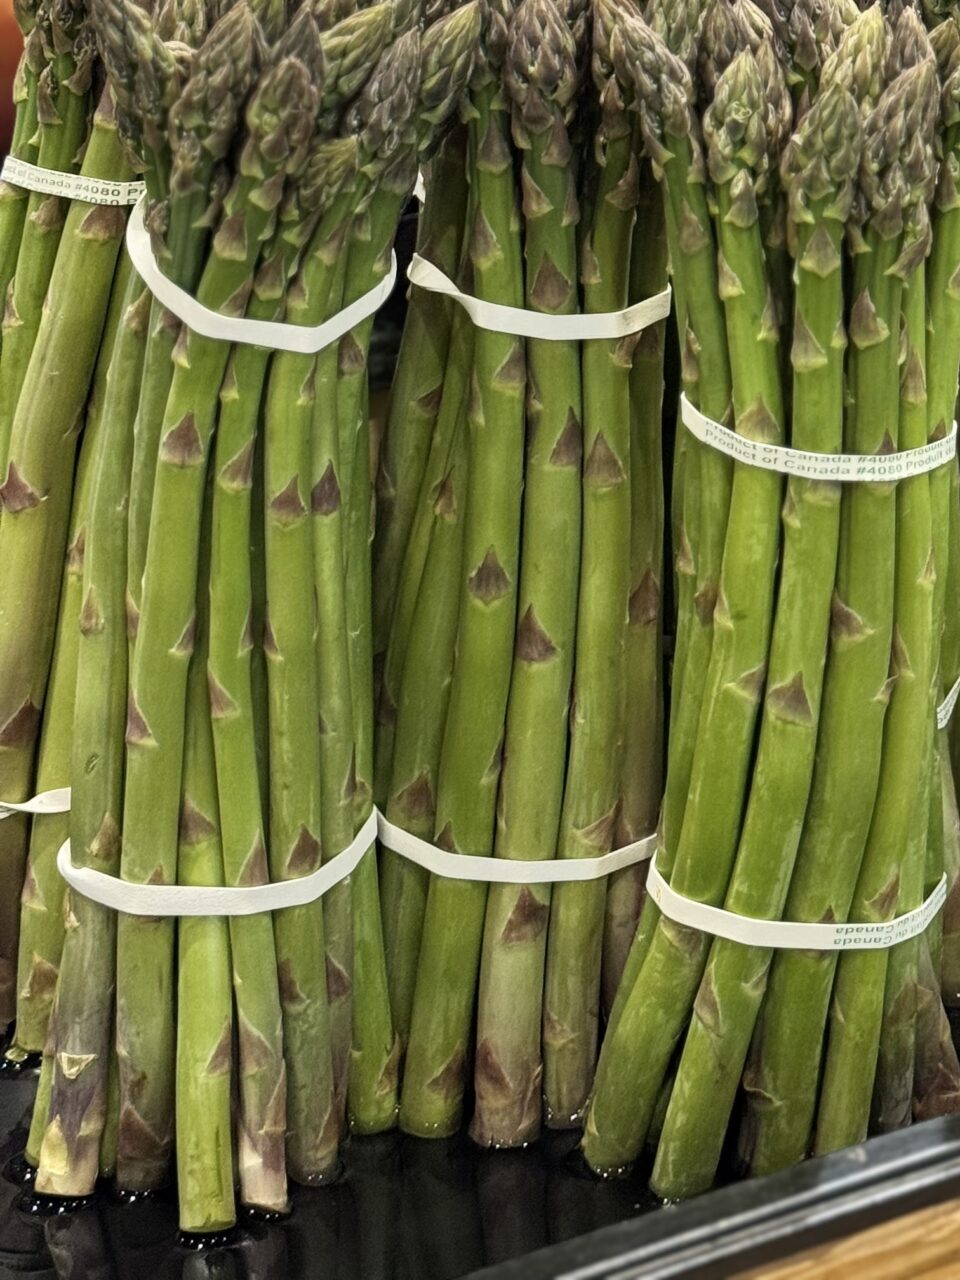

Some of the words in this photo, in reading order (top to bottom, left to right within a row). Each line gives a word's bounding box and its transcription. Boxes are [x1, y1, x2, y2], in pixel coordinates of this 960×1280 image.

[27, 172, 72, 190] Canada
[75, 183, 121, 197] #4080
[705, 428, 757, 461] Product
[763, 457, 778, 466] of
[784, 459, 851, 475] Canada
[856, 464, 903, 475] #4080
[906, 451, 943, 471] Produit
[835, 925, 894, 935] Canada
[833, 935, 892, 946] Canada
